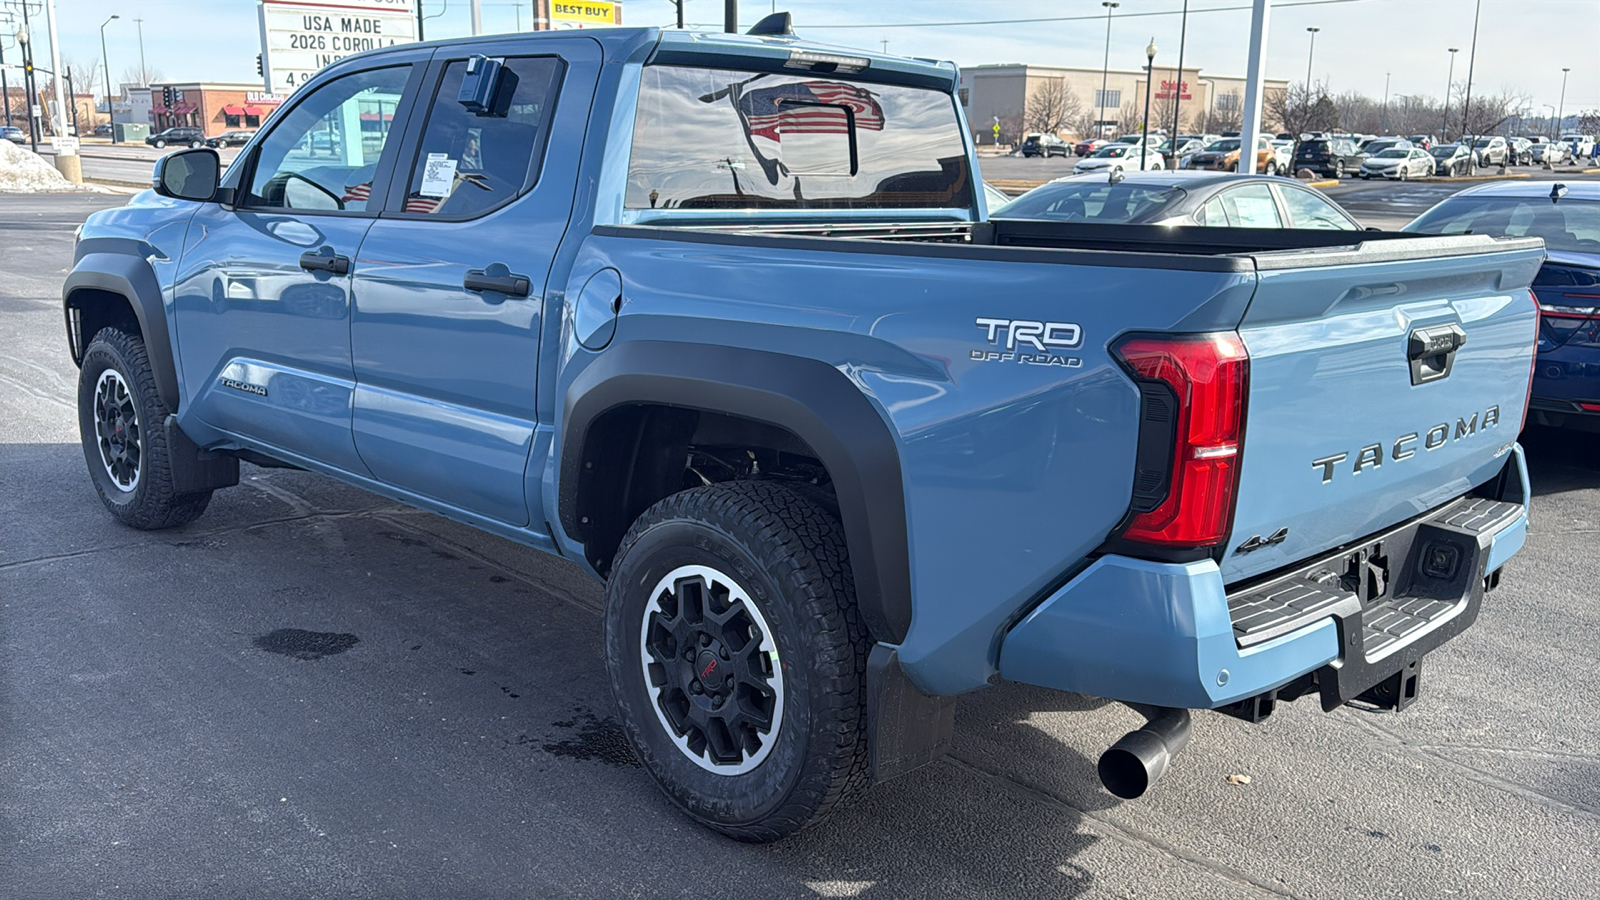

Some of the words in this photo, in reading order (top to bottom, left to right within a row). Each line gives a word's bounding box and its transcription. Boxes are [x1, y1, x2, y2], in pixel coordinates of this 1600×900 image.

[555, 4, 583, 15] BEST
[585, 7, 609, 17] BUY
[303, 15, 332, 31] USA
[341, 18, 381, 34] MADE
[290, 34, 326, 50] 2026
[975, 317, 1084, 352] TRD
[969, 349, 1015, 363] OFF
[1017, 352, 1083, 368] ROAD
[221, 377, 268, 397] TACOMA
[1311, 404, 1500, 485] TACOMA
[701, 659, 717, 678] TRD
